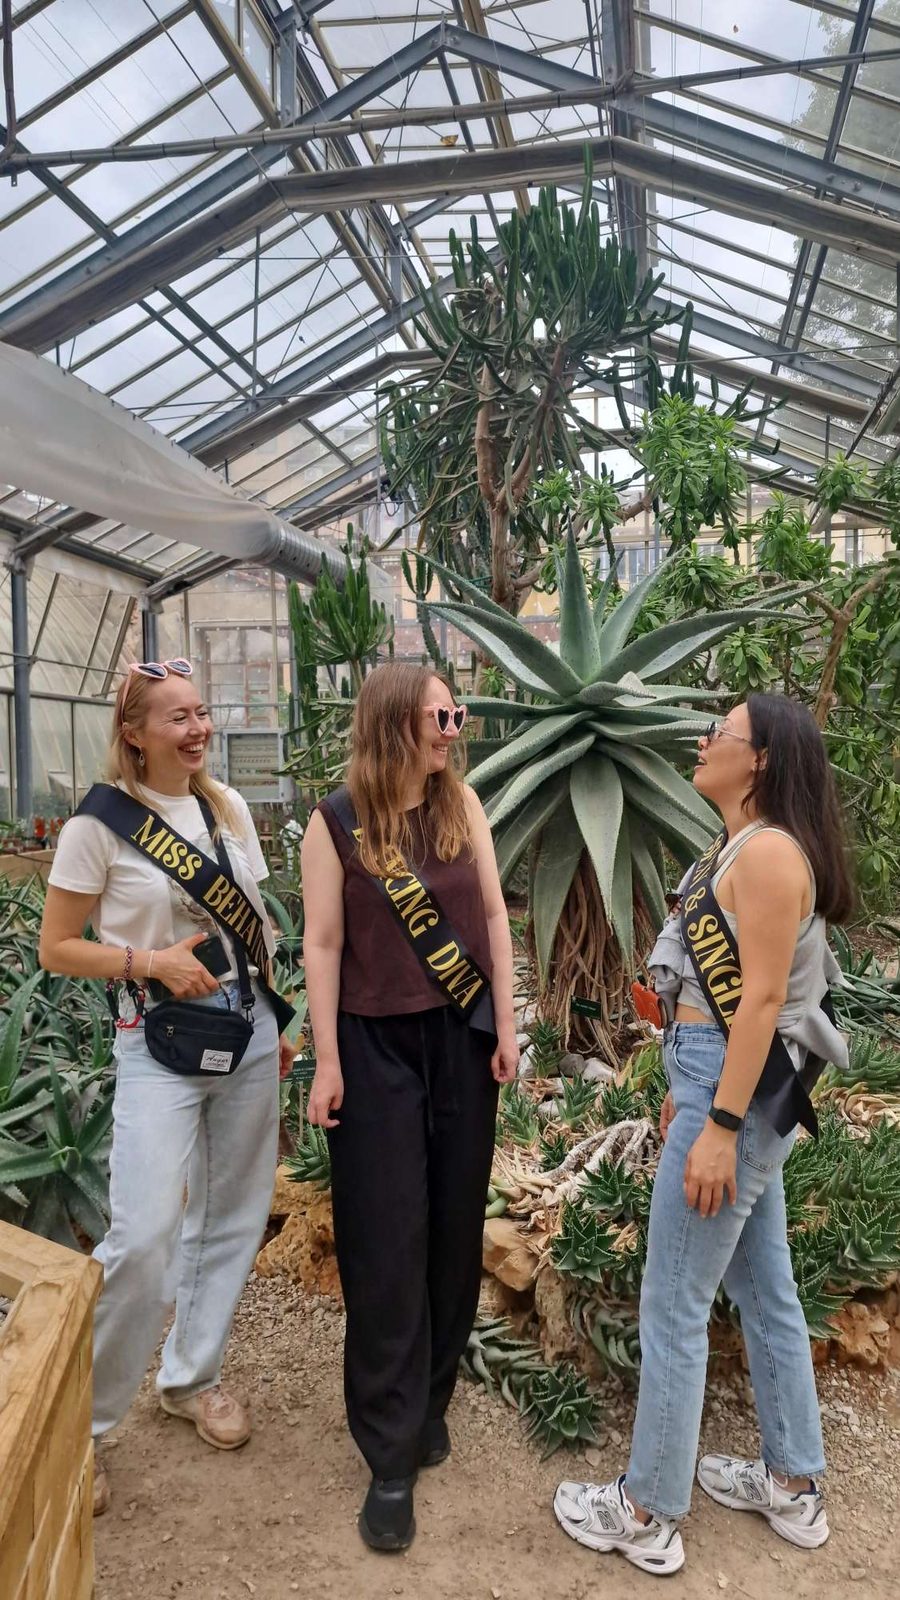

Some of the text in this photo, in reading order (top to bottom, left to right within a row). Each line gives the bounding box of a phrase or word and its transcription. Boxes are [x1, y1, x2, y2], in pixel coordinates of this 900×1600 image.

[130, 814, 203, 881] MISS
[684, 886, 707, 918] &
[426, 940, 484, 1009] DIVA
